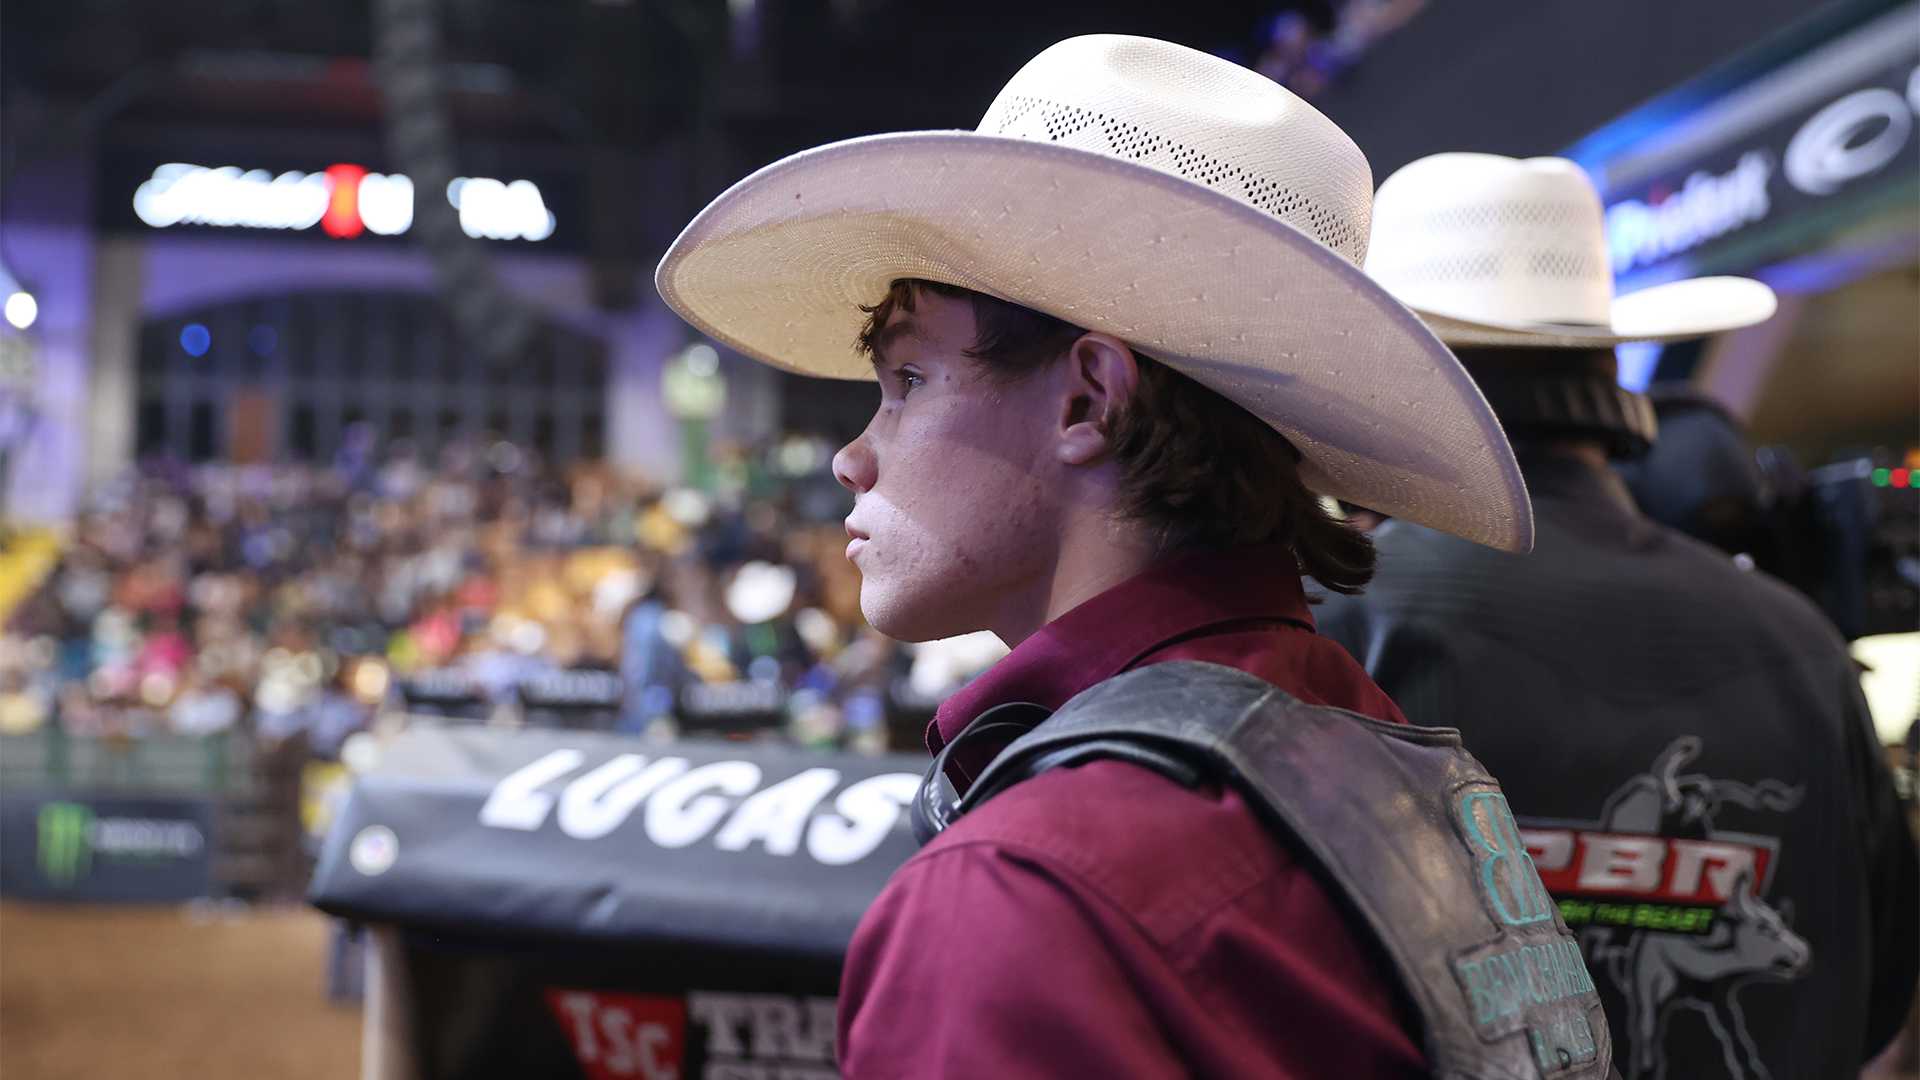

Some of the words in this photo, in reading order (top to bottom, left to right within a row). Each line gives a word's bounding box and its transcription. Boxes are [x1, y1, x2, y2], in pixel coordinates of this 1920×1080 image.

[480, 749, 922, 865] LUCAS
[1521, 829, 1756, 899] PBR
[559, 993, 678, 1080] TSC
